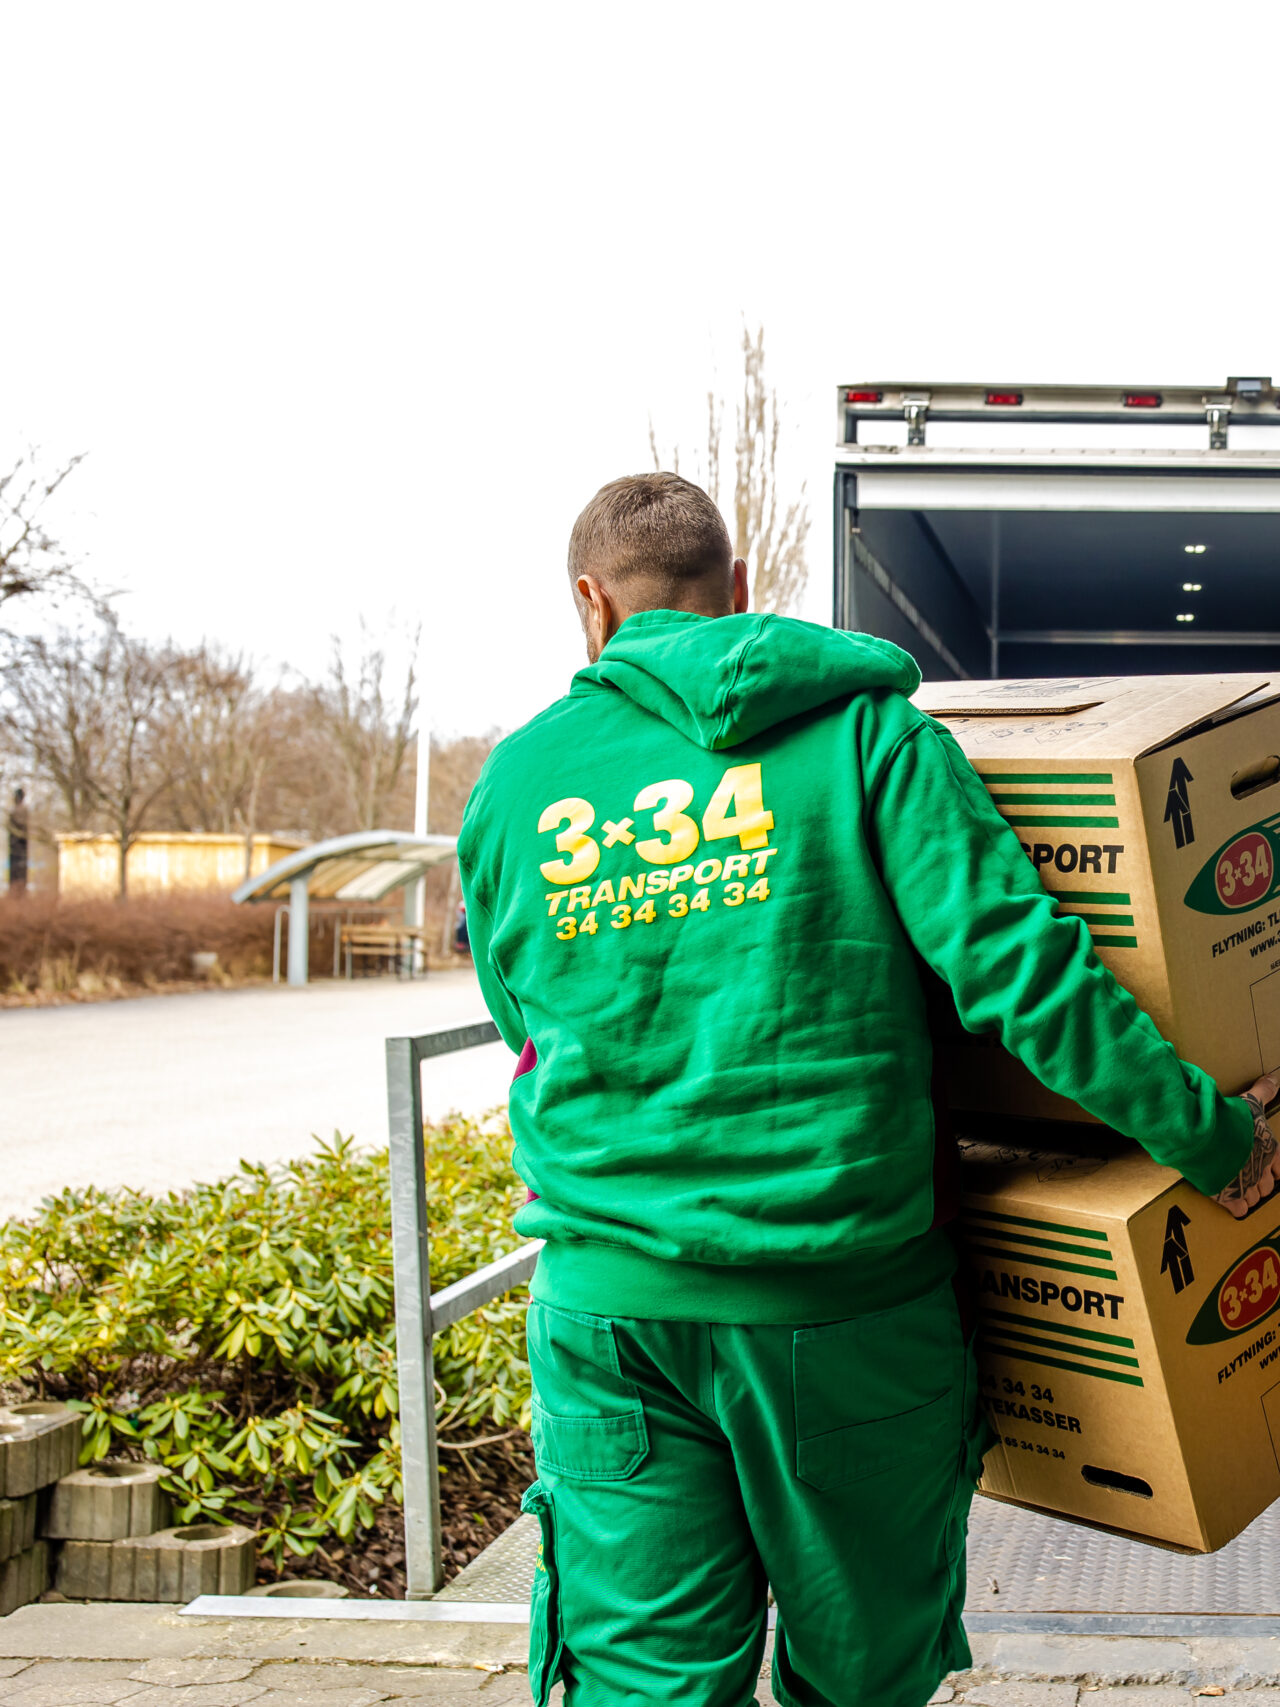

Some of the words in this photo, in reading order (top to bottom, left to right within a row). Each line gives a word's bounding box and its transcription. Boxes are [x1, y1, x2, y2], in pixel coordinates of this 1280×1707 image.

[545, 848, 779, 917] TRANSPORT
[555, 911, 599, 941] 34
[610, 900, 657, 930] 34
[668, 888, 711, 918] 34
[722, 877, 771, 908] 34
[1211, 920, 1266, 958] FLYTNING:
[1217, 1329, 1276, 1385] FLYTNING:
[1002, 1378, 1025, 1397] 34
[1030, 1384, 1054, 1403] 34
[1020, 1440, 1034, 1452] 34
[1036, 1444, 1050, 1456] 34
[1052, 1448, 1066, 1460] 34
